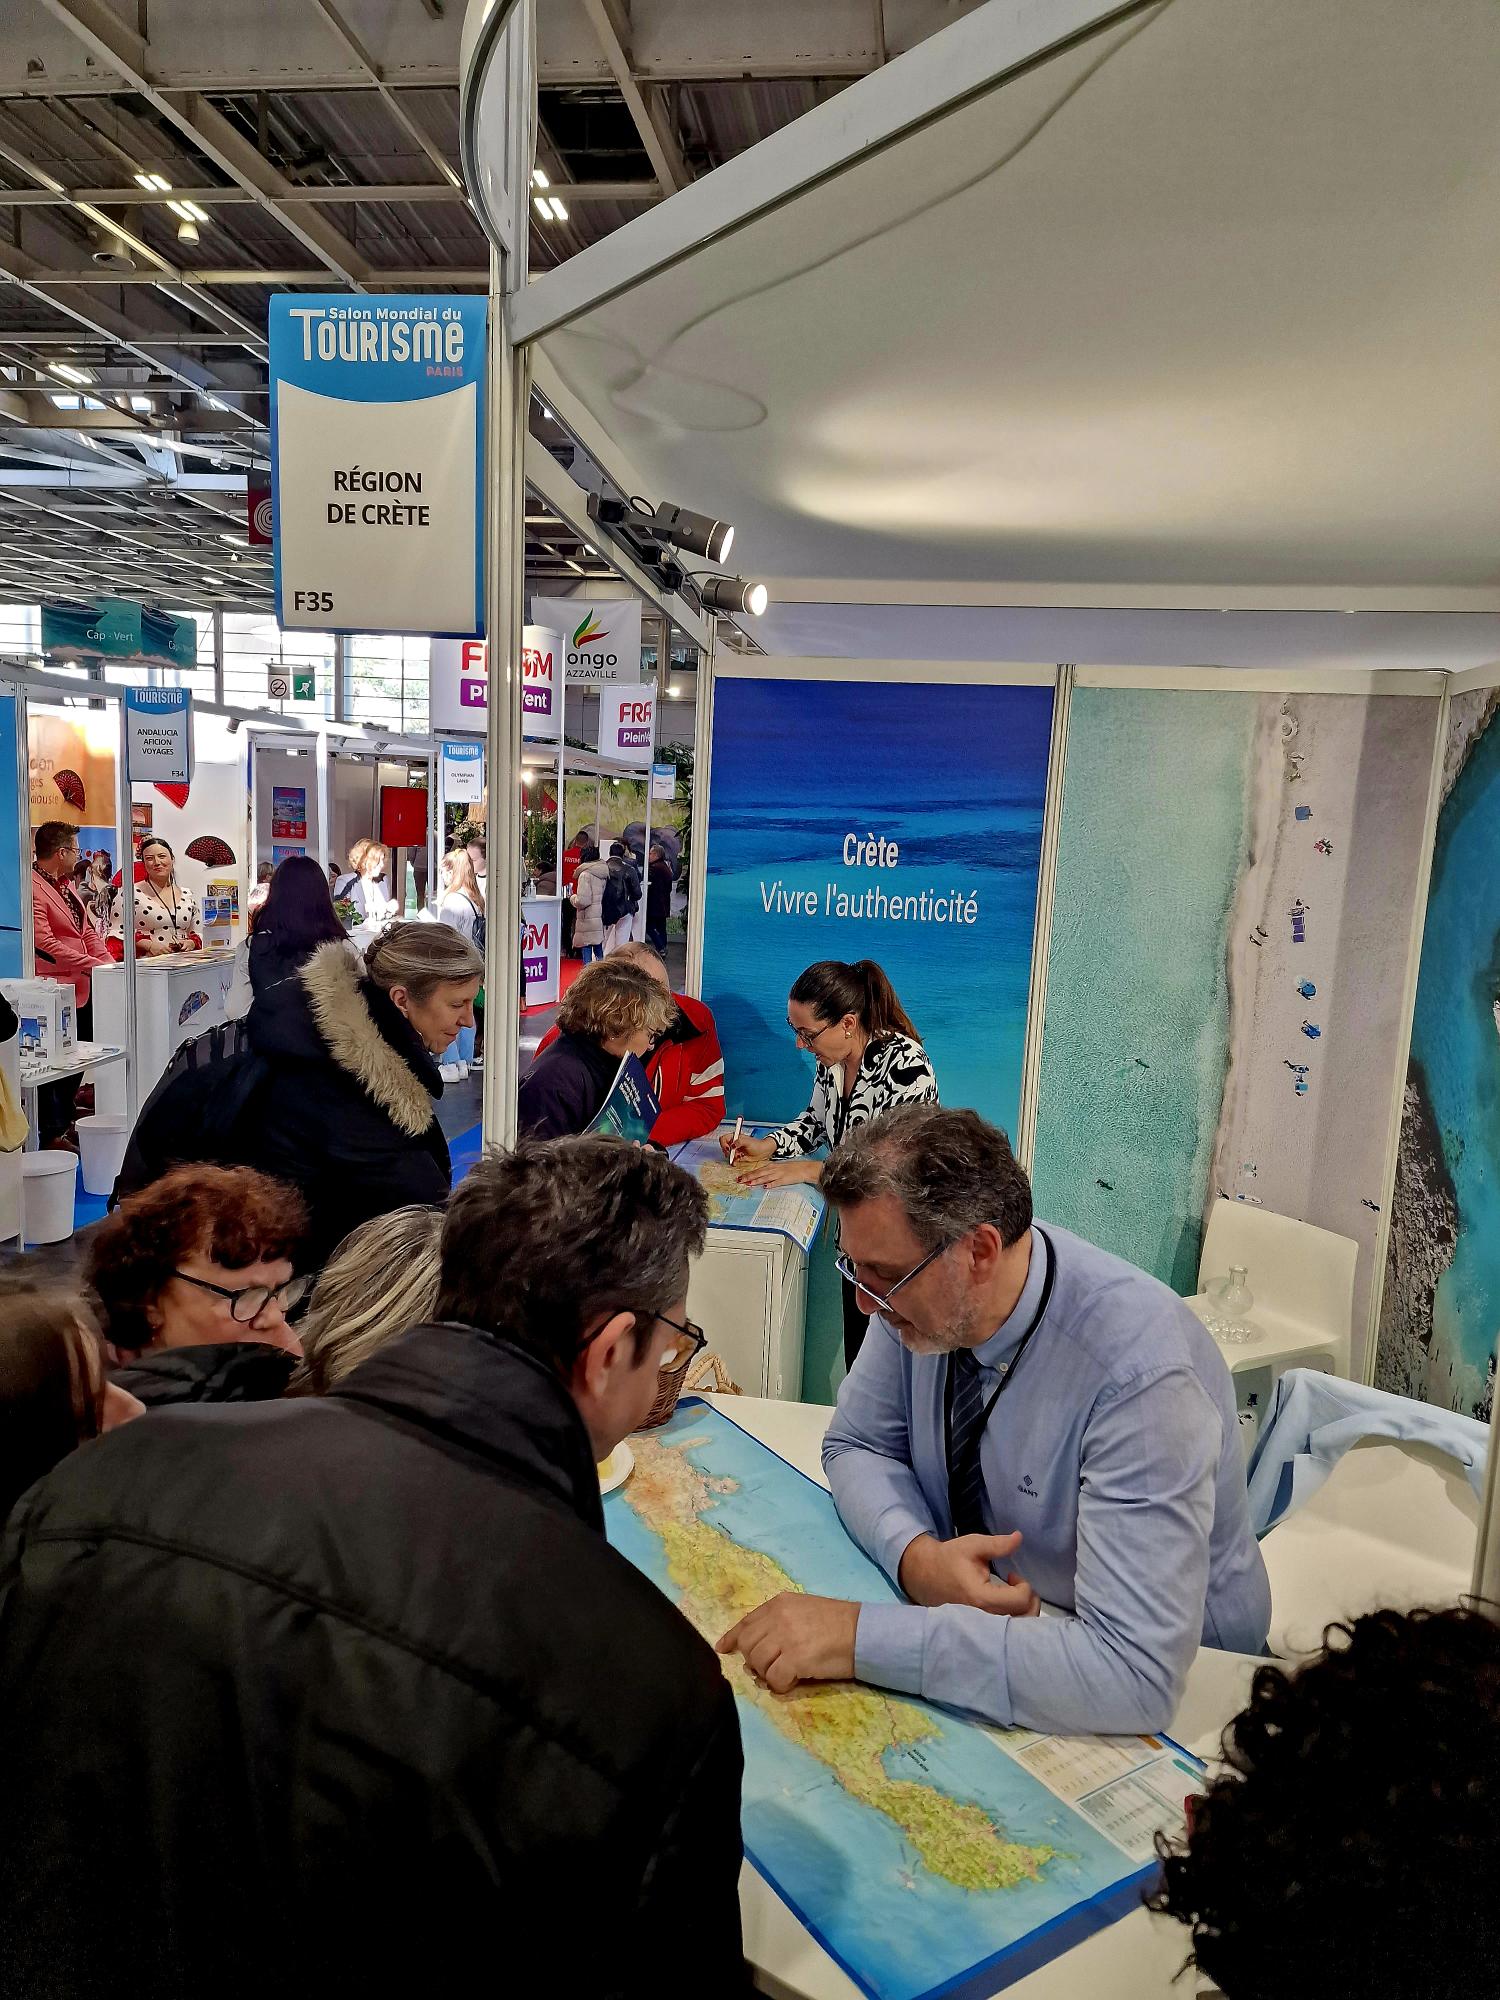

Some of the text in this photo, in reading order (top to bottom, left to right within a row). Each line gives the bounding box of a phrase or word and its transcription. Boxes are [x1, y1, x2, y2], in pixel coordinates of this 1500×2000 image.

[329, 307, 462, 320] Salon Mondial du
[426, 366, 463, 377] PARIS
[334, 465, 422, 493] RÉGION
[327, 499, 430, 526] DE CRÈTE
[294, 591, 334, 612] F35
[86, 630, 106, 641] Cap
[113, 631, 134, 642] Vert
[567, 652, 618, 669] ongo
[566, 669, 617, 679] AZZAVILLE
[619, 701, 653, 722] FRA
[137, 728, 178, 737] ANDALUCIA
[143, 738, 172, 746] AFICION
[843, 832, 899, 868] Crète
[760, 880, 978, 924] Vivre l'authenticité
